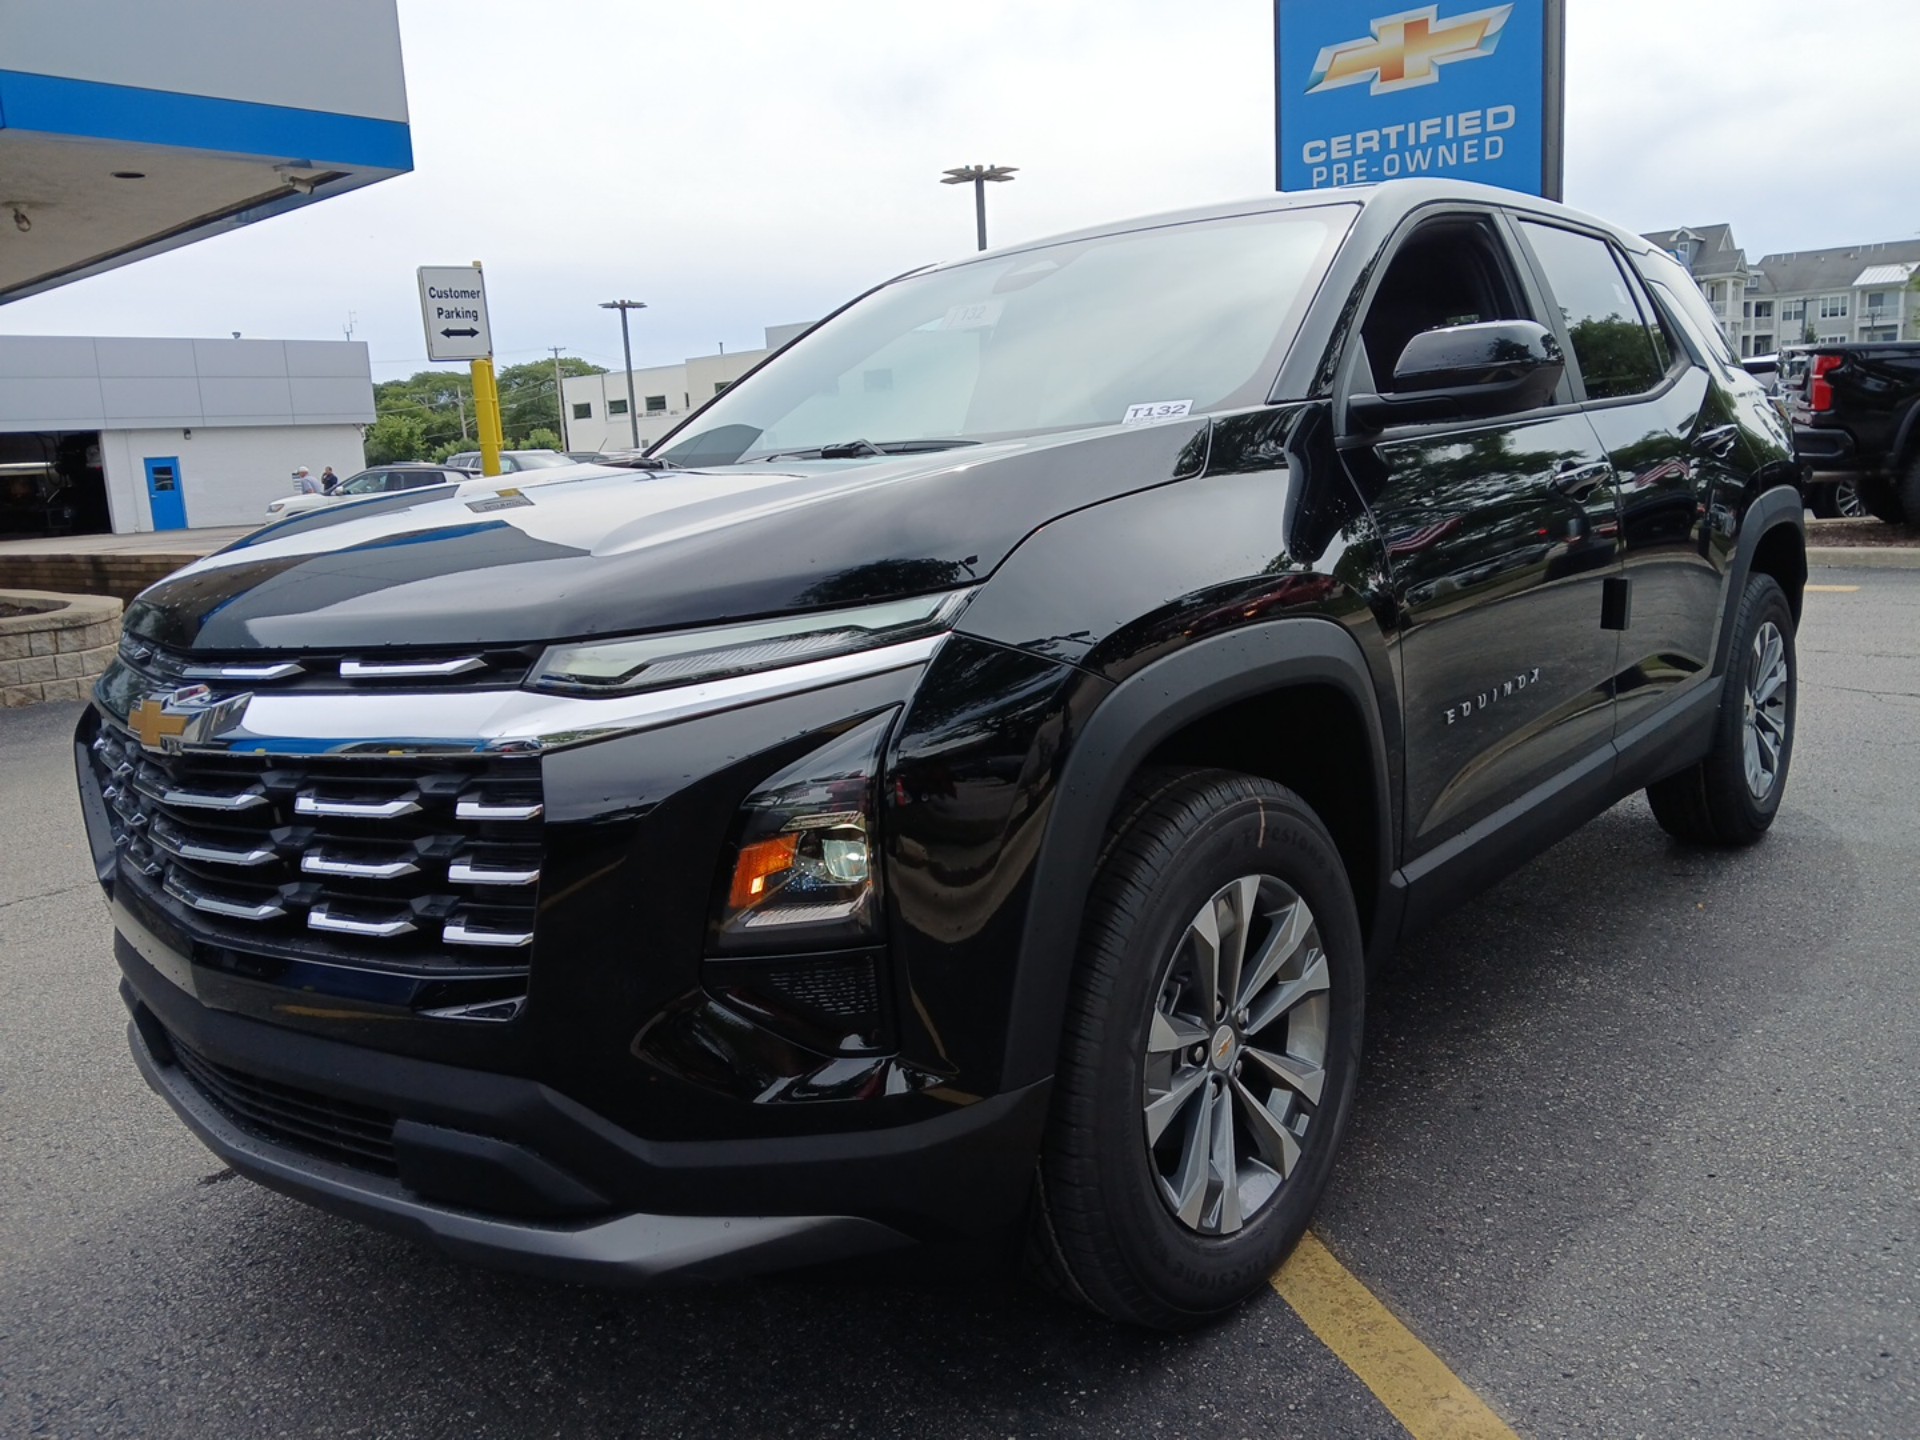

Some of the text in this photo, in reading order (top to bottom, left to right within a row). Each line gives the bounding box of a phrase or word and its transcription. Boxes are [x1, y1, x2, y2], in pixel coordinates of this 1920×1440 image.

[1302, 104, 1516, 164] CERTIFIED
[1312, 135, 1504, 189] PRE-OWNED
[428, 286, 481, 299] Customer
[436, 306, 479, 322] Parking
[1131, 404, 1187, 418] T132
[1443, 667, 1540, 725] EQUINOX
